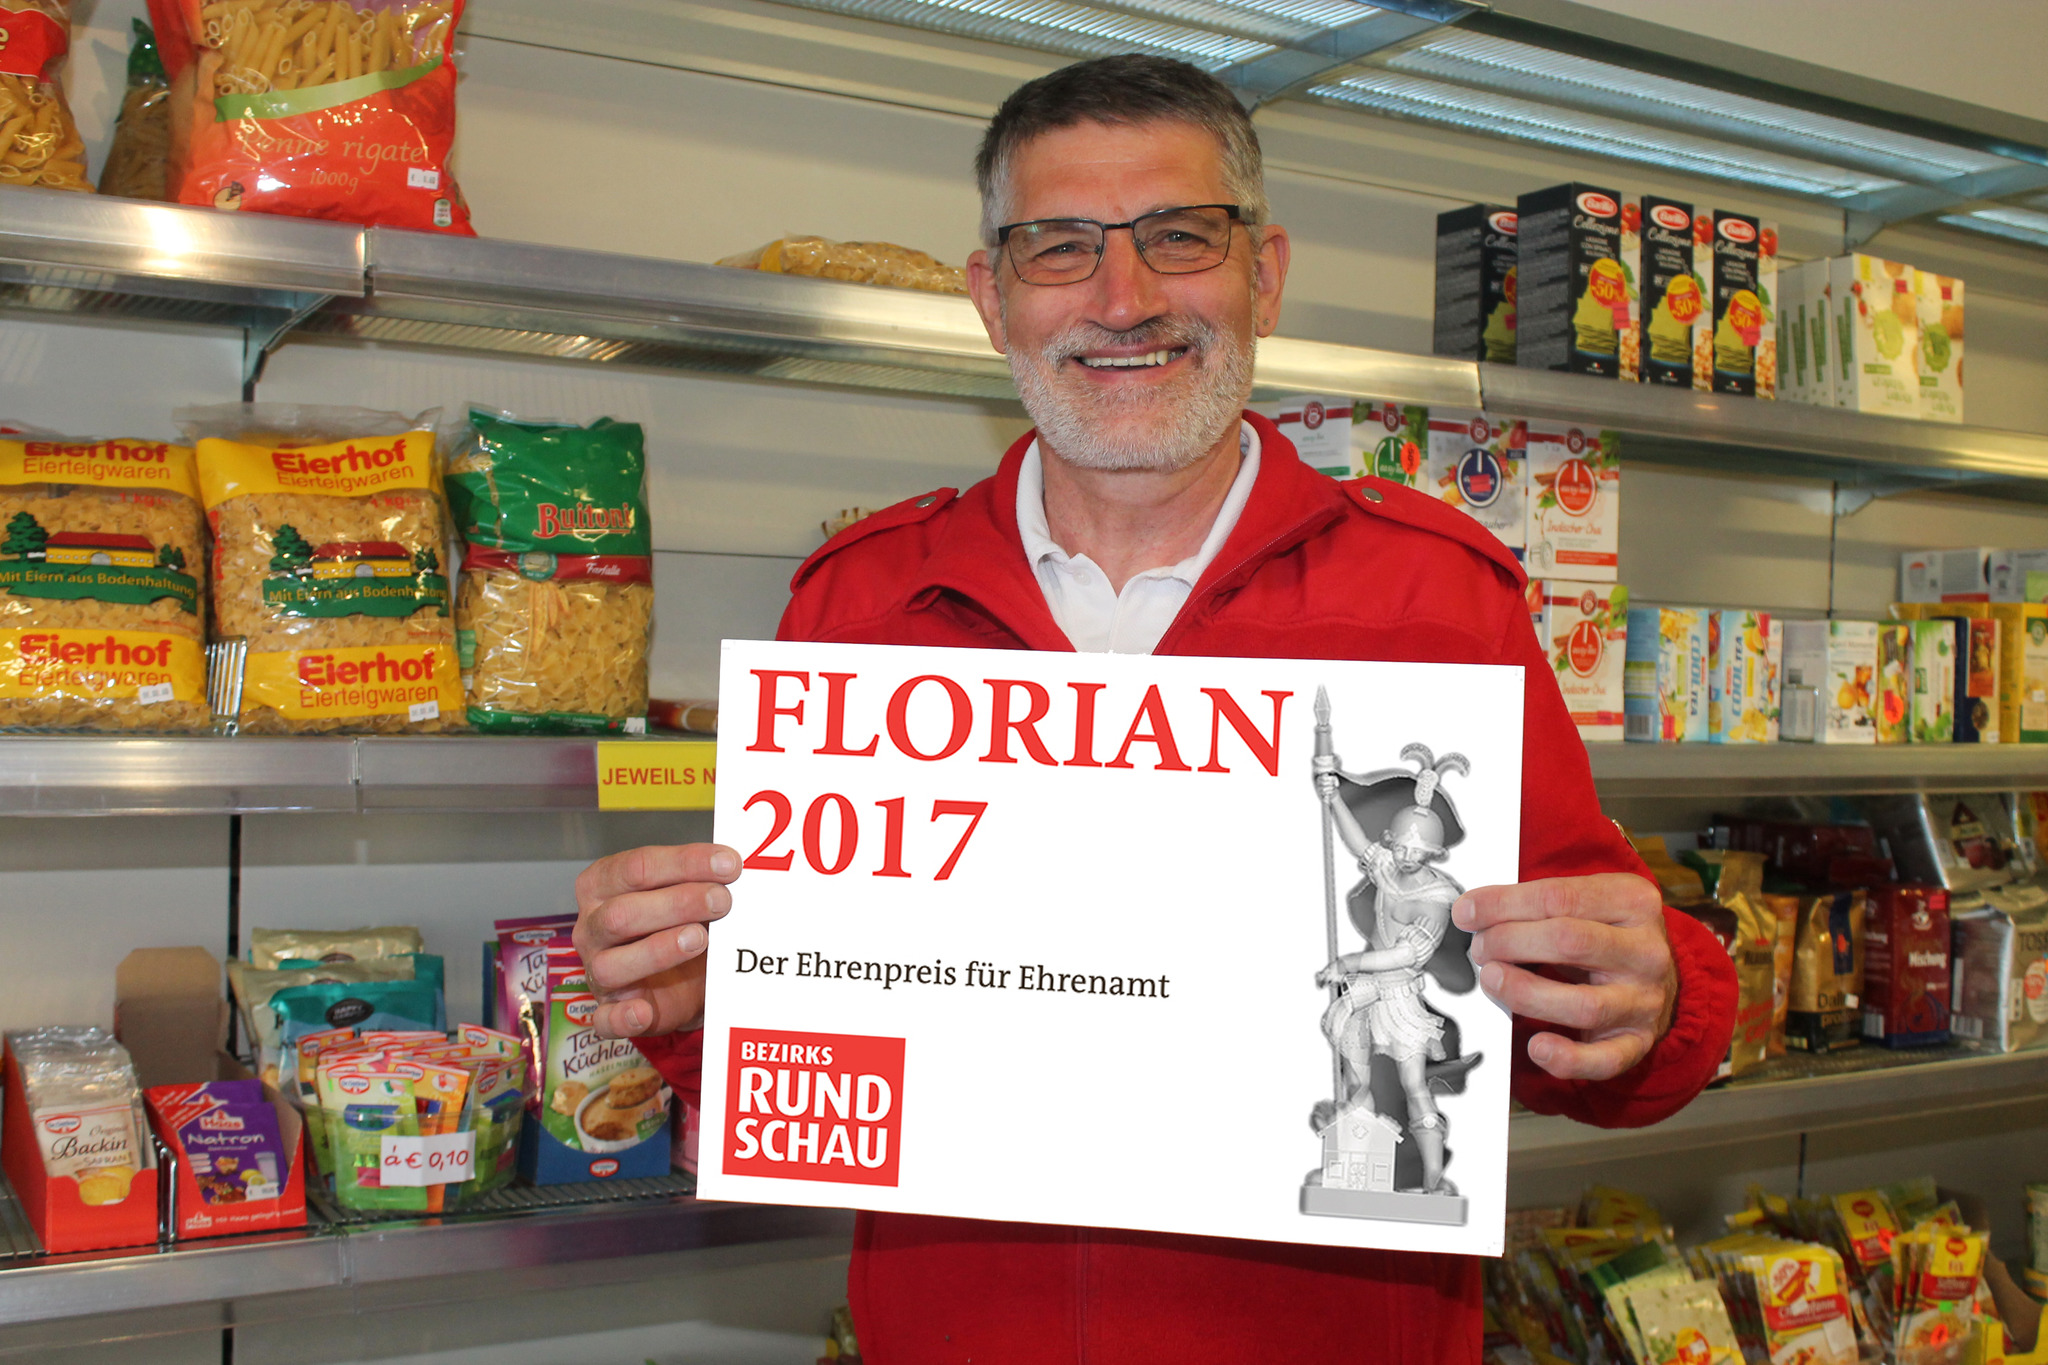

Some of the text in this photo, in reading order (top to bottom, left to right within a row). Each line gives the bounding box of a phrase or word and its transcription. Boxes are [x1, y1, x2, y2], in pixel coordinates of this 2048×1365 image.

[242, 132, 424, 175] Penne rigate
[310, 171, 359, 195] 1000g
[24, 441, 169, 463] Eierhof
[271, 439, 407, 475] Eierhof
[23, 457, 171, 480] Eierteigwaren
[276, 465, 415, 492] Eierteigwaren
[532, 502, 632, 539] Buitoni
[0, 570, 195, 598] Mit Eiern aus Bodenhaltung
[269, 588, 288, 602] Mit
[335, 587, 359, 600] aus
[20, 634, 172, 667] Eierhof
[18, 666, 172, 692] Eierteigwaren
[298, 651, 436, 686] Eierhof
[300, 685, 439, 709] Eierteigwaren
[746, 669, 1294, 776] FLORIAN
[602, 768, 696, 785] JEWEILS
[743, 790, 988, 881] 2017
[736, 949, 1169, 998] Der Ehrenpreis für Ehrenamt
[741, 1041, 833, 1065] BEZIRKS
[738, 1066, 893, 1122] RUND
[51, 1135, 128, 1161] Backin
[188, 1131, 265, 1145] Natron
[733, 1117, 888, 1169] SCHAU
[405, 1151, 423, 1169] €
[429, 1149, 470, 1170] 0,10
